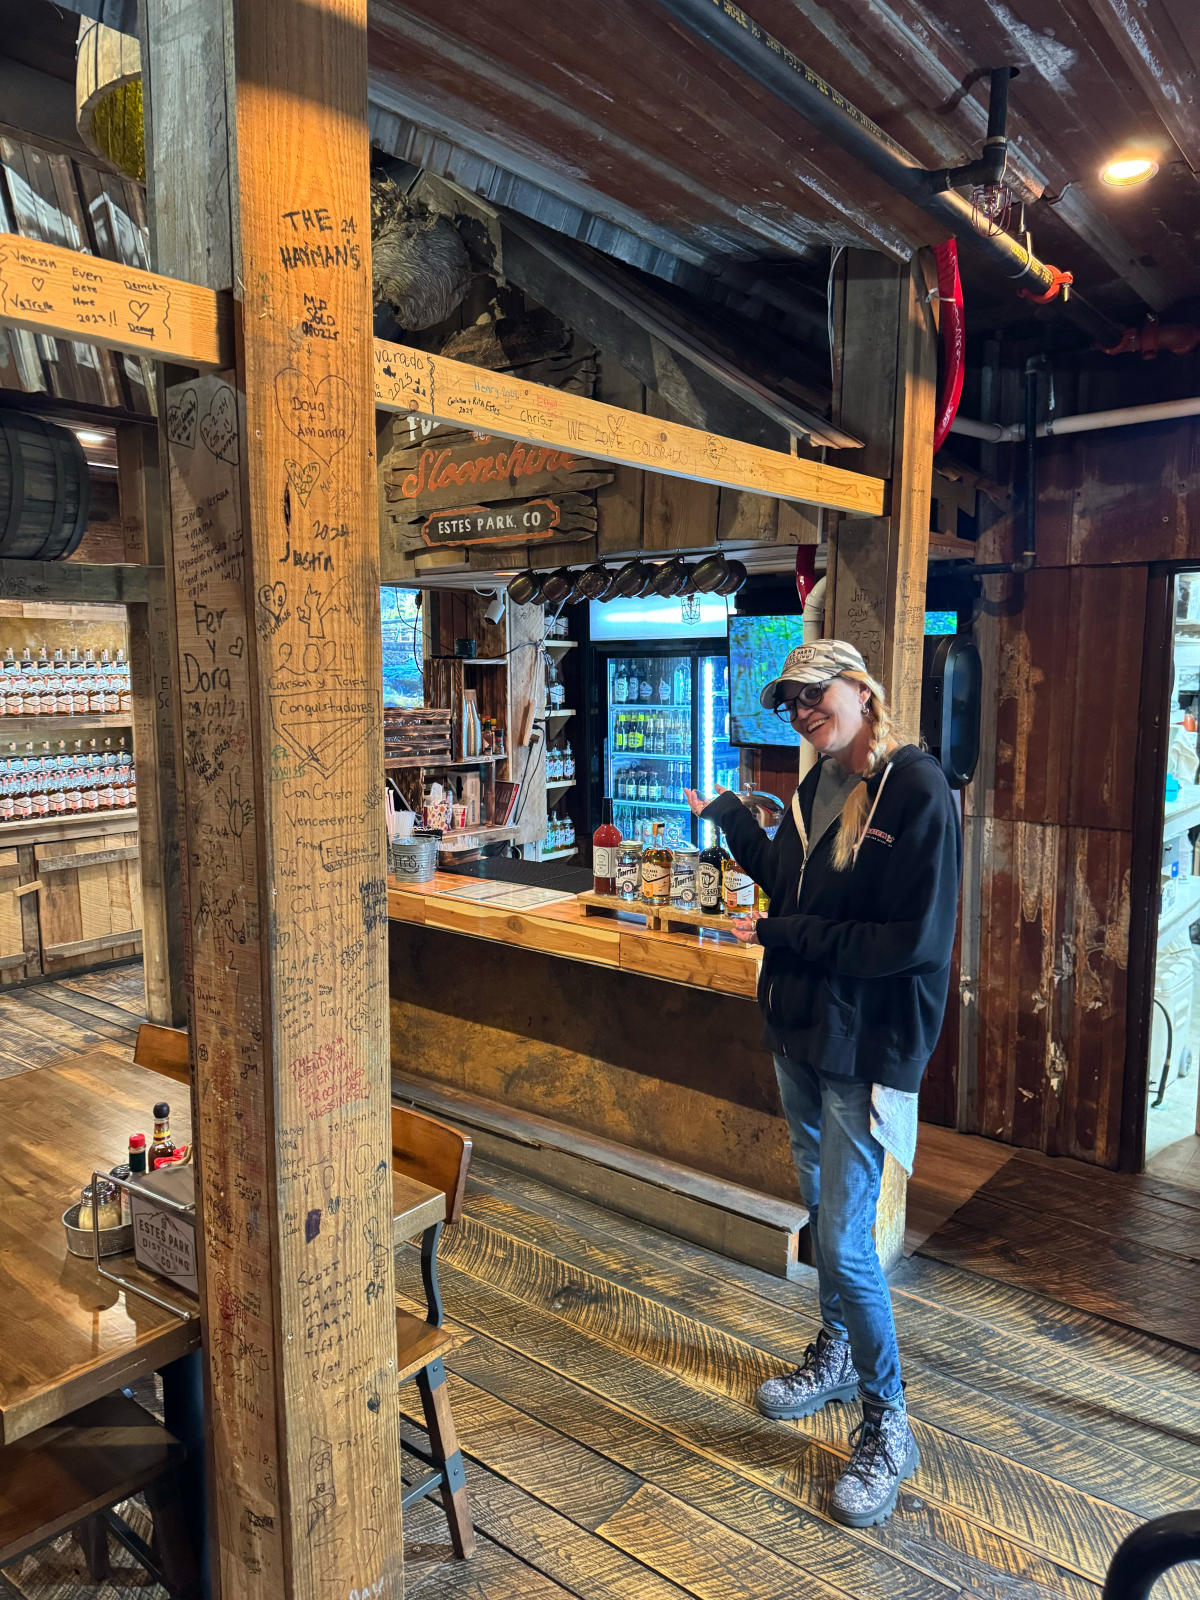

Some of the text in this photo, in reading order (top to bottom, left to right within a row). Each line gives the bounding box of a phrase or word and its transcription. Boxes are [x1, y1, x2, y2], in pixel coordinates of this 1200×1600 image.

[281, 207, 333, 232] THE
[291, 396, 327, 421] Doug
[296, 424, 346, 440] Amanda
[567, 420, 588, 442] WE
[437, 517, 472, 535] ESTES
[522, 511, 542, 527] CO
[194, 600, 228, 636] Fer
[274, 641, 356, 676] 2024
[183, 652, 231, 694] Dora
[280, 696, 375, 718] Conquistadores
[139, 1218, 191, 1257] ESTES PARK
[142, 1237, 190, 1272] DISTILLING
[160, 1256, 172, 1270] CO
